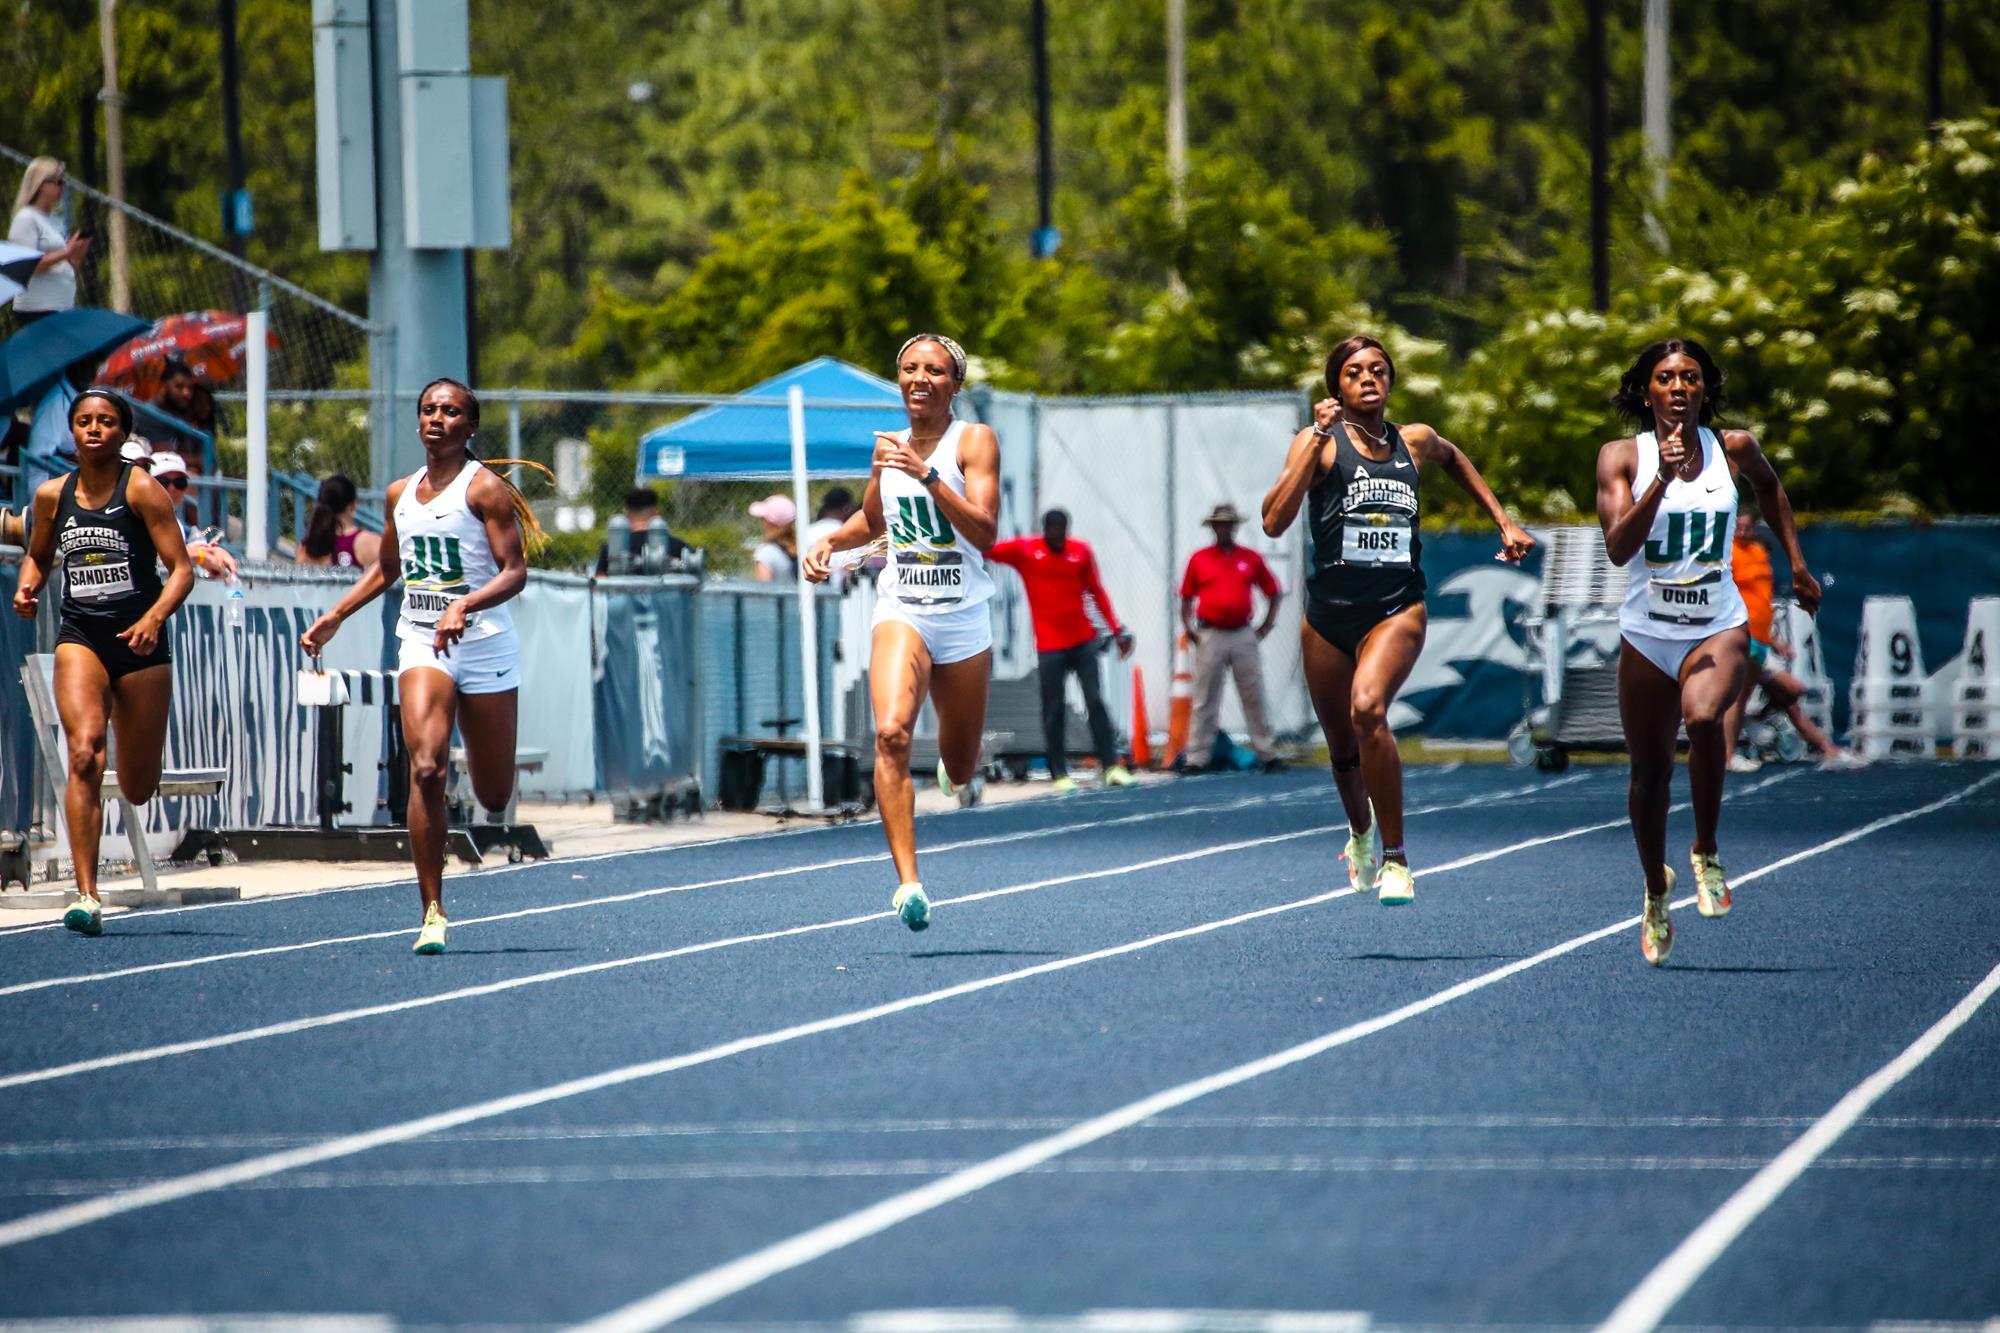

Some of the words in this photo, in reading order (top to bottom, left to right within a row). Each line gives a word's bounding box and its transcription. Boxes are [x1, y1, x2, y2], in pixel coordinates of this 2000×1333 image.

[1347, 478, 1415, 498] CENTRAL
[1342, 489, 1418, 512] ARKANSAS
[891, 496, 957, 548] JU
[60, 527, 124, 542] CENTRAL
[61, 536, 129, 552] ARKANSAS
[1358, 531, 1399, 550] ROSE
[1645, 511, 1730, 567] JU
[405, 535, 464, 585] JU
[70, 566, 129, 586] SANDERS
[898, 567, 961, 586] WILLIAMS
[409, 593, 458, 612] DAVIDS
[1889, 632, 1914, 676] 9
